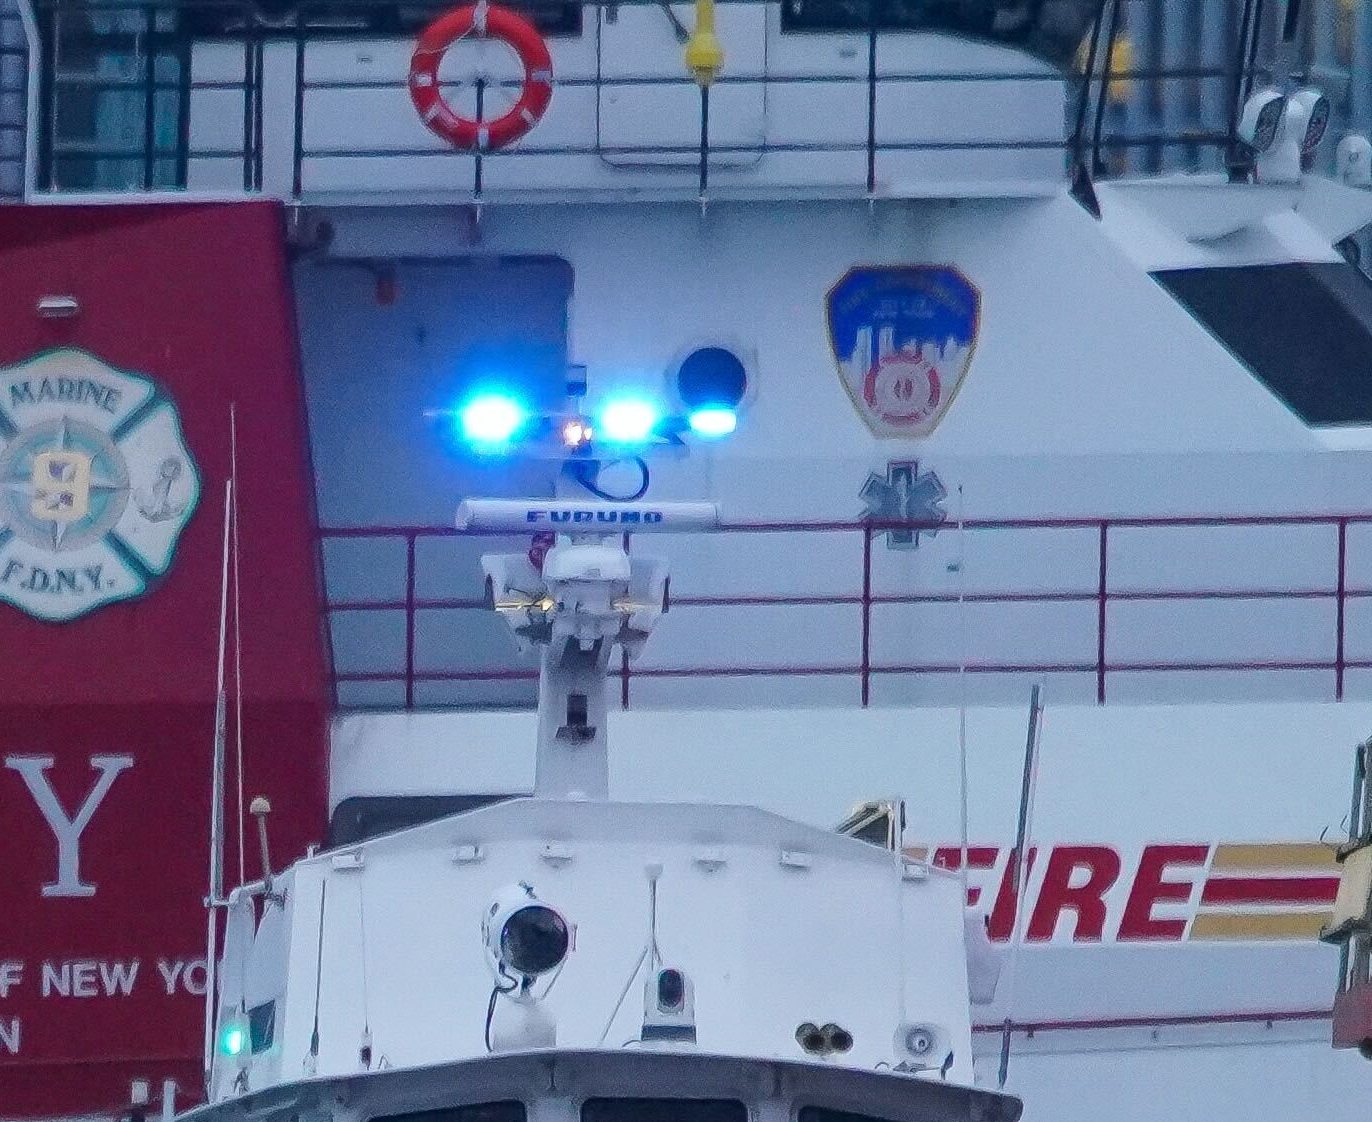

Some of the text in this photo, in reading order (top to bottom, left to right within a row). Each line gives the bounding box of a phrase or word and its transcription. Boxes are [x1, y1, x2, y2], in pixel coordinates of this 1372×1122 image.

[9, 375, 123, 414] MARINE
[527, 511, 662, 523] FURUNO
[41, 960, 139, 998] NEW
